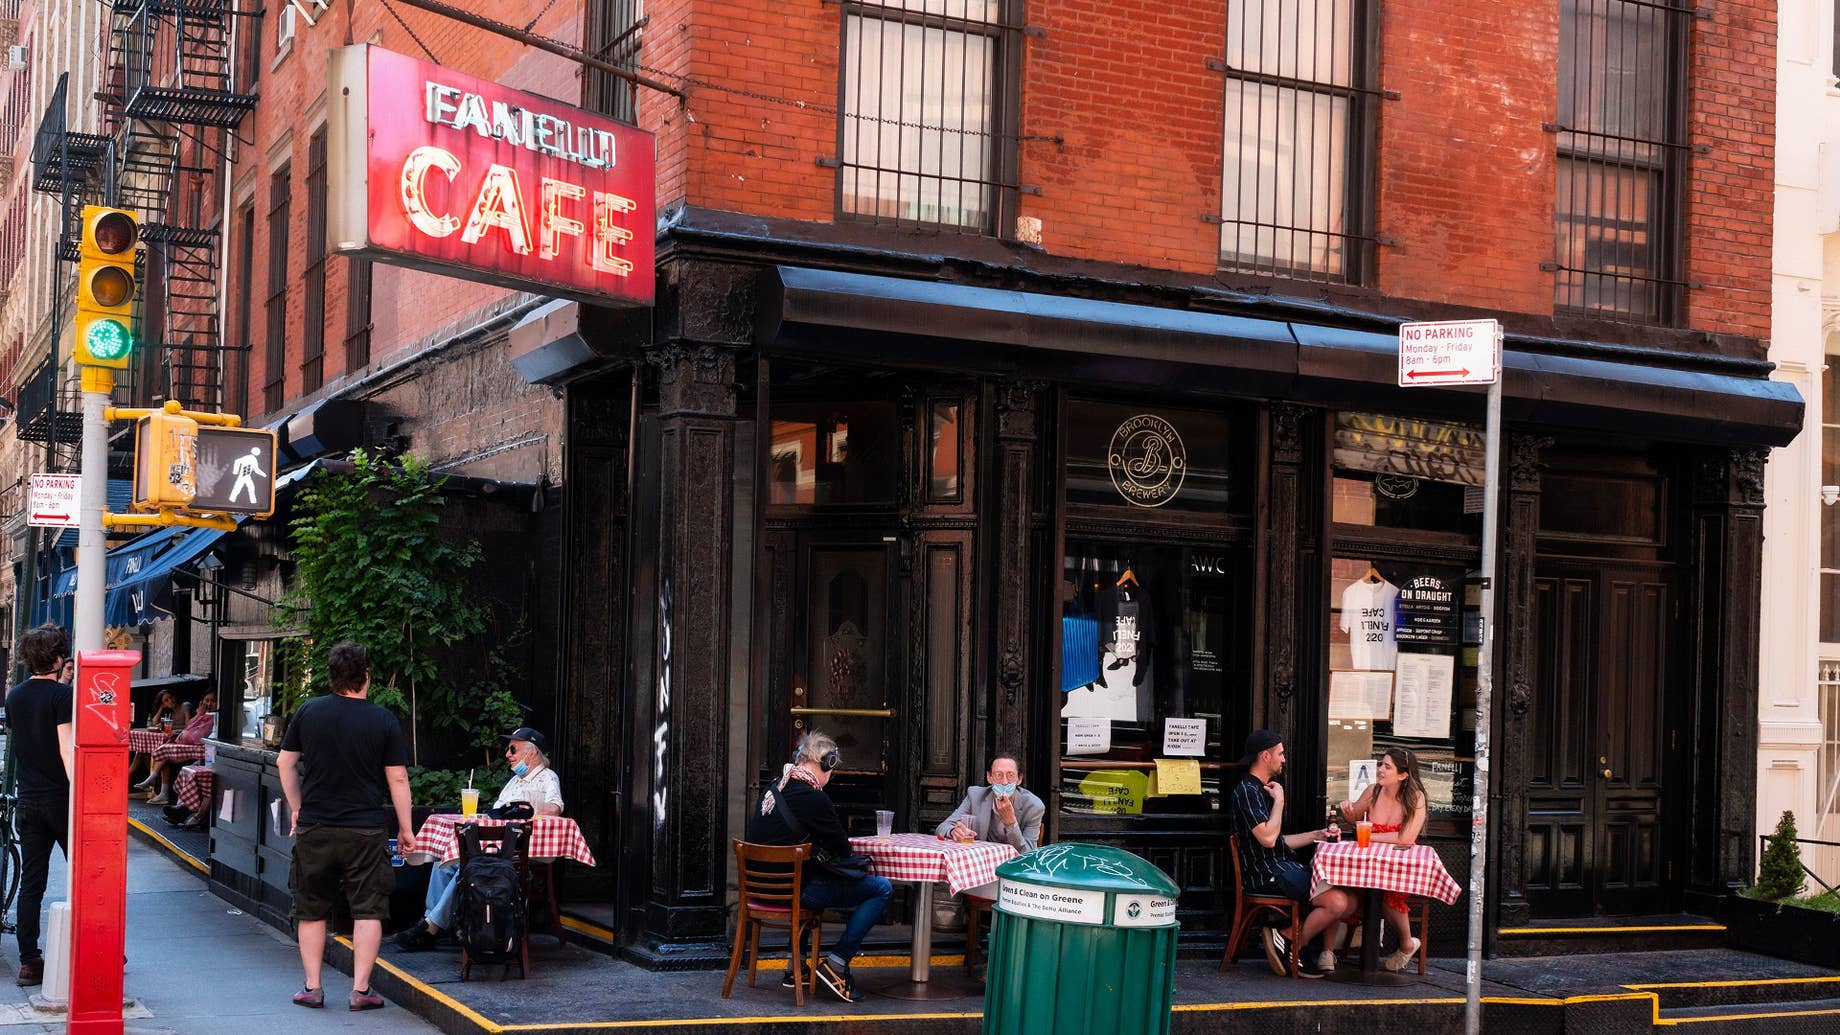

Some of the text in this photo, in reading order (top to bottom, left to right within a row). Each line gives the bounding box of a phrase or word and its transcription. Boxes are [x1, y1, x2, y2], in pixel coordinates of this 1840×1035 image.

[401, 146, 637, 277] CAFE
[1406, 327, 1473, 340] NO PARKING
[1406, 343, 1437, 353] Monday
[1446, 342, 1473, 352] Friday
[1405, 355, 1424, 365] 8am
[1432, 355, 1451, 364] 6pm
[1119, 417, 1176, 443] BROOKLYN
[34, 480, 75, 489] NO PARKING
[1122, 480, 1171, 499] BREWERY
[34, 491, 53, 500] Monday
[1413, 577, 1441, 589] BEERS
[1401, 590, 1452, 602] ON DRAUGHT
[1361, 608, 1385, 617] CAFE
[1354, 765, 1371, 790] A
[1108, 787, 1130, 795] CAFE
[1002, 884, 1013, 894] Green
[1019, 889, 1038, 899] Clean
[1052, 894, 1084, 904] Greene
